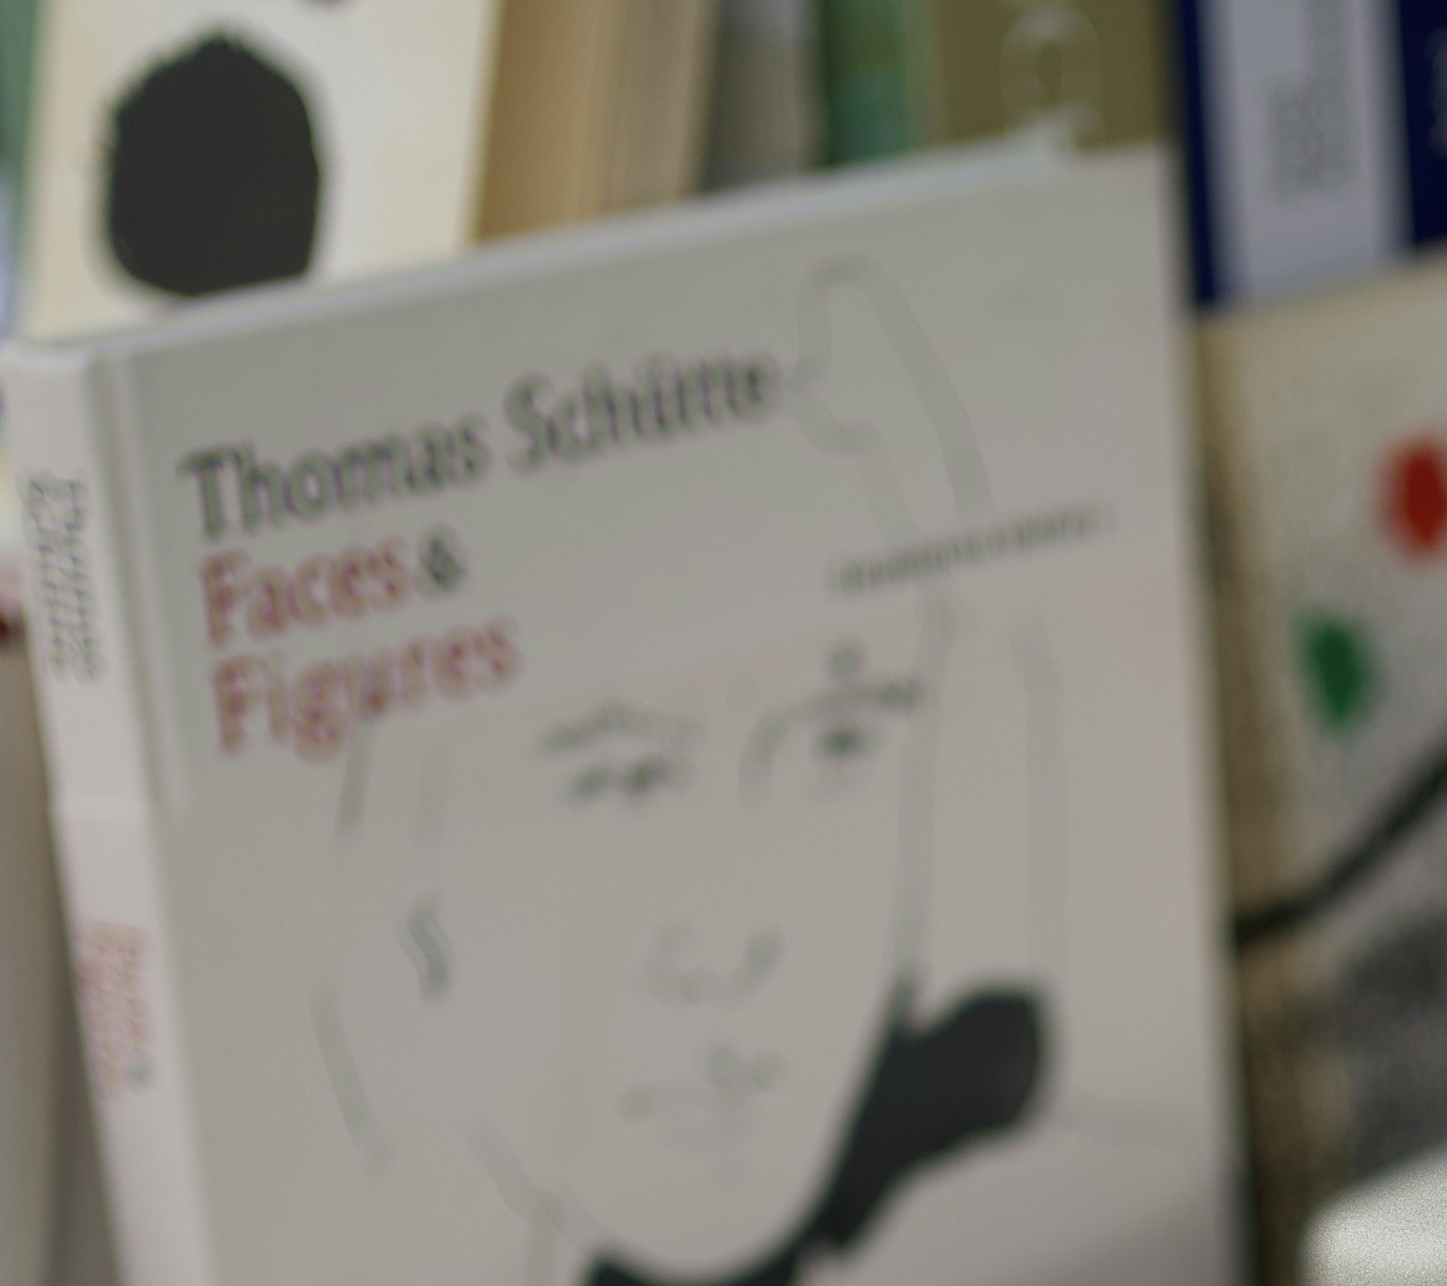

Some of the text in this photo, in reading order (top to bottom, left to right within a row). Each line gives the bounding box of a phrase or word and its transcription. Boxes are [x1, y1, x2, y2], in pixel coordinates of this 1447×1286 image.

[175, 350, 782, 543] Thomas Schütte
[200, 522, 468, 649] Faces &
[212, 614, 524, 760] Figures
